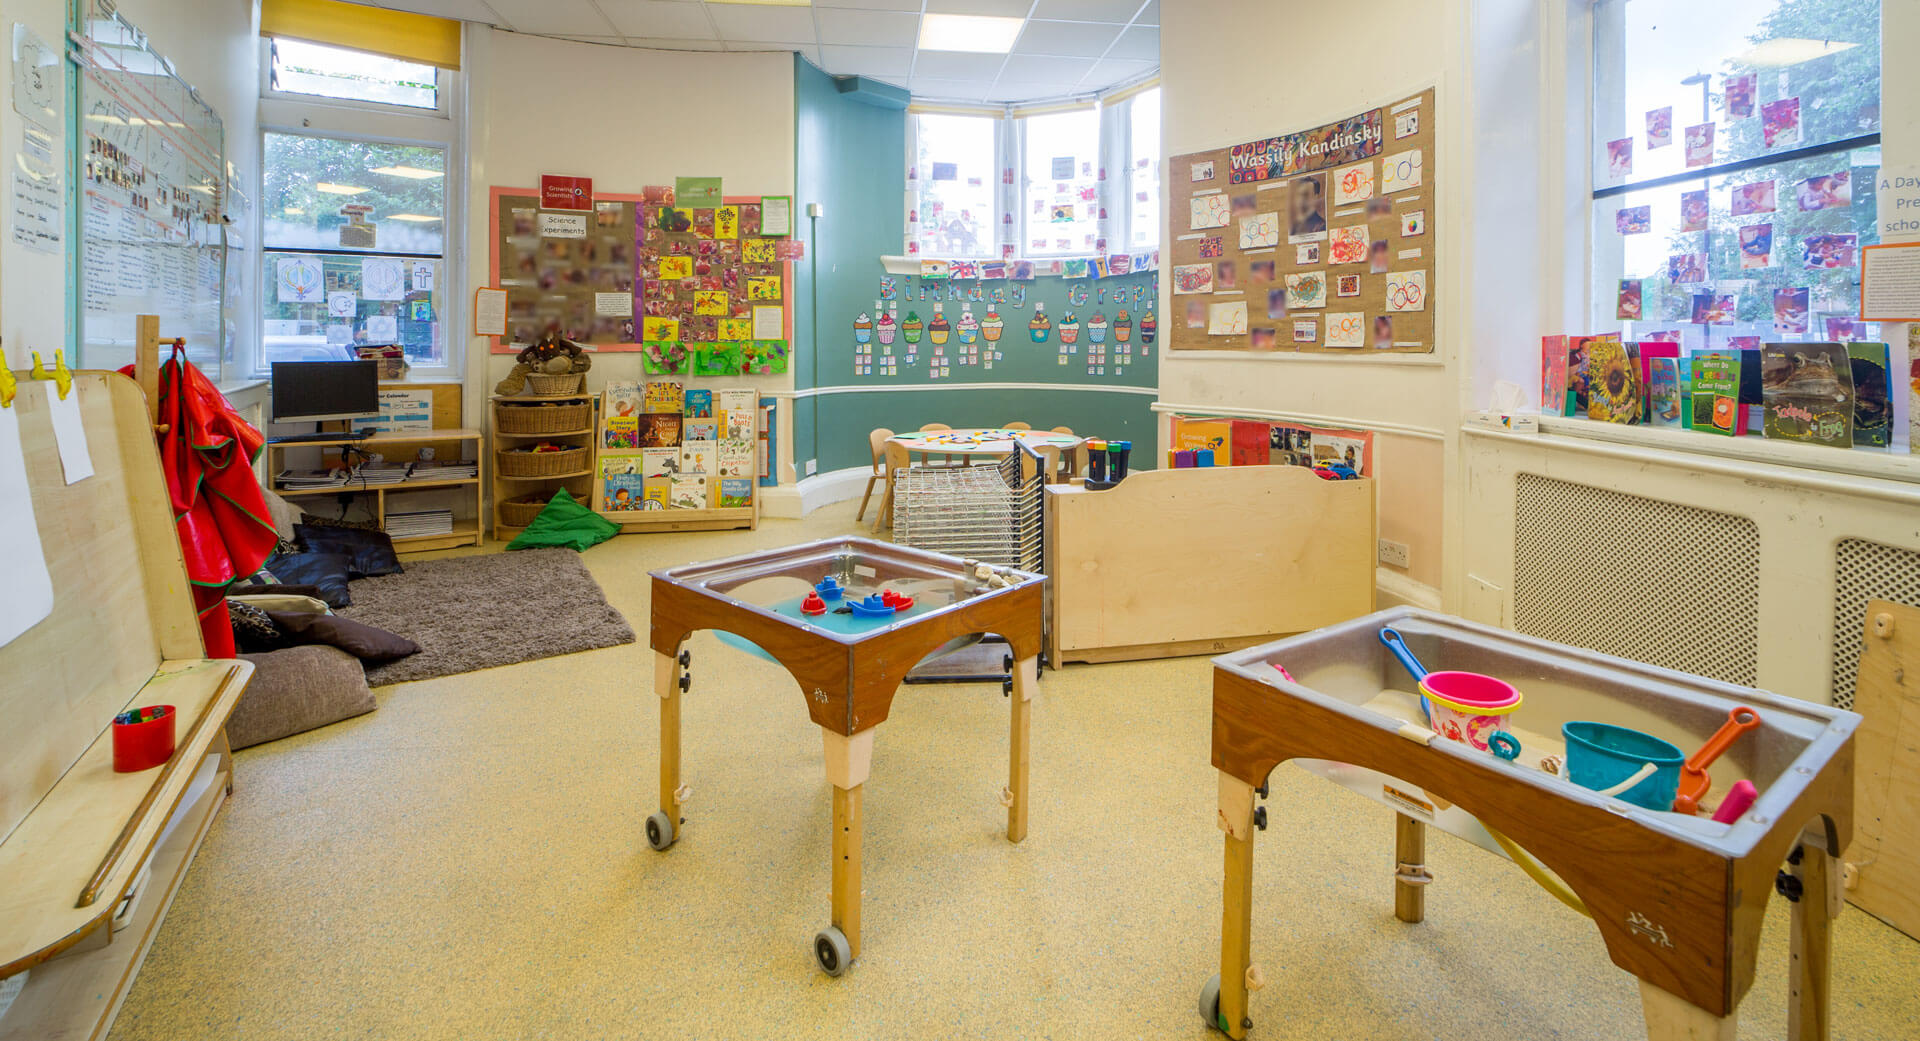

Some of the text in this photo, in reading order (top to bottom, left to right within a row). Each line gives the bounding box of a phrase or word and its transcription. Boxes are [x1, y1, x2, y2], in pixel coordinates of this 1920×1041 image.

[1232, 124, 1381, 169] Wassily Kandinsky
[548, 185, 573, 193] Growing
[1880, 179, 1890, 190] A
[1896, 198, 1920, 209] Pre
[548, 216, 576, 225] Science
[1886, 219, 1920, 232] scho
[880, 275, 1027, 309] Birthday
[1694, 370, 1736, 382] Vegetables
[1714, 383, 1731, 391] From?
[1772, 403, 1813, 422] Tadpole
[1819, 420, 1844, 438] Frog
